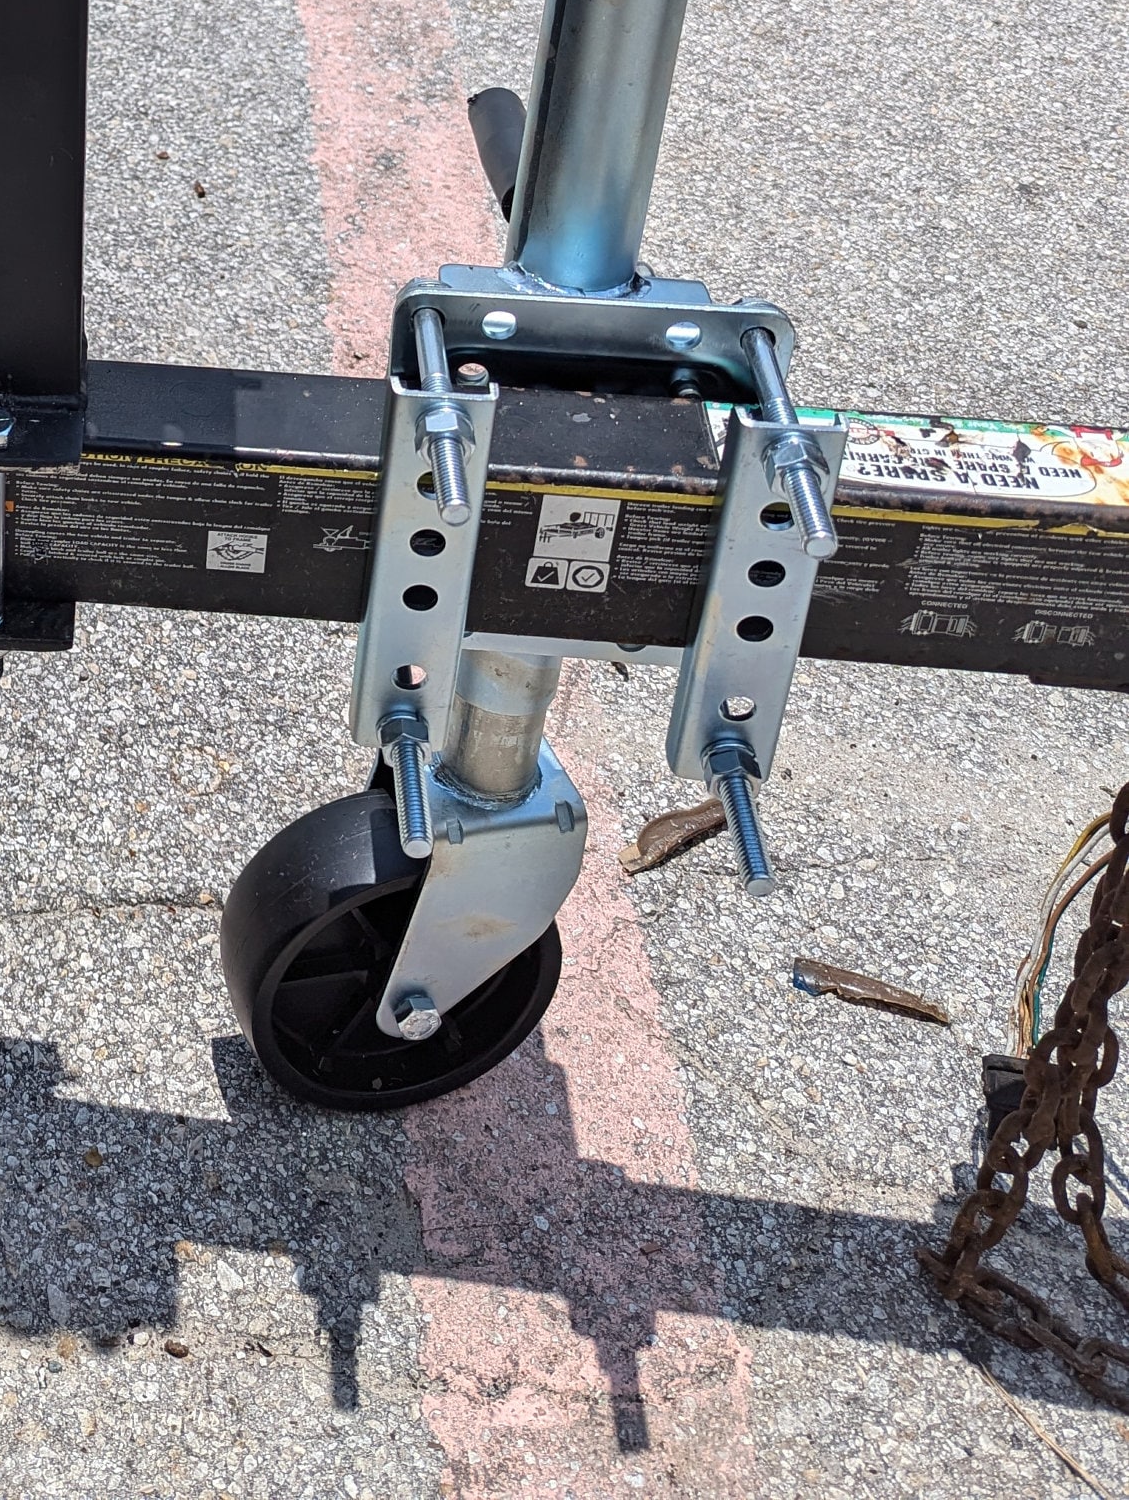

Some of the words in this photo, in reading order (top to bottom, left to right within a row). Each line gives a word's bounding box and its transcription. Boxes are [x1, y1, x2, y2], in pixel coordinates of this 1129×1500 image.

[843, 451, 903, 464] CARRI
[934, 449, 946, 457] IN
[857, 463, 947, 482] SPARE?
[955, 460, 1011, 474] SPARE
[1038, 466, 1082, 478] NEED
[953, 471, 970, 483] A
[982, 473, 1040, 489] NEED
[921, 600, 967, 608] CONNECTED
[1035, 609, 1092, 618] DISCONNECTED
